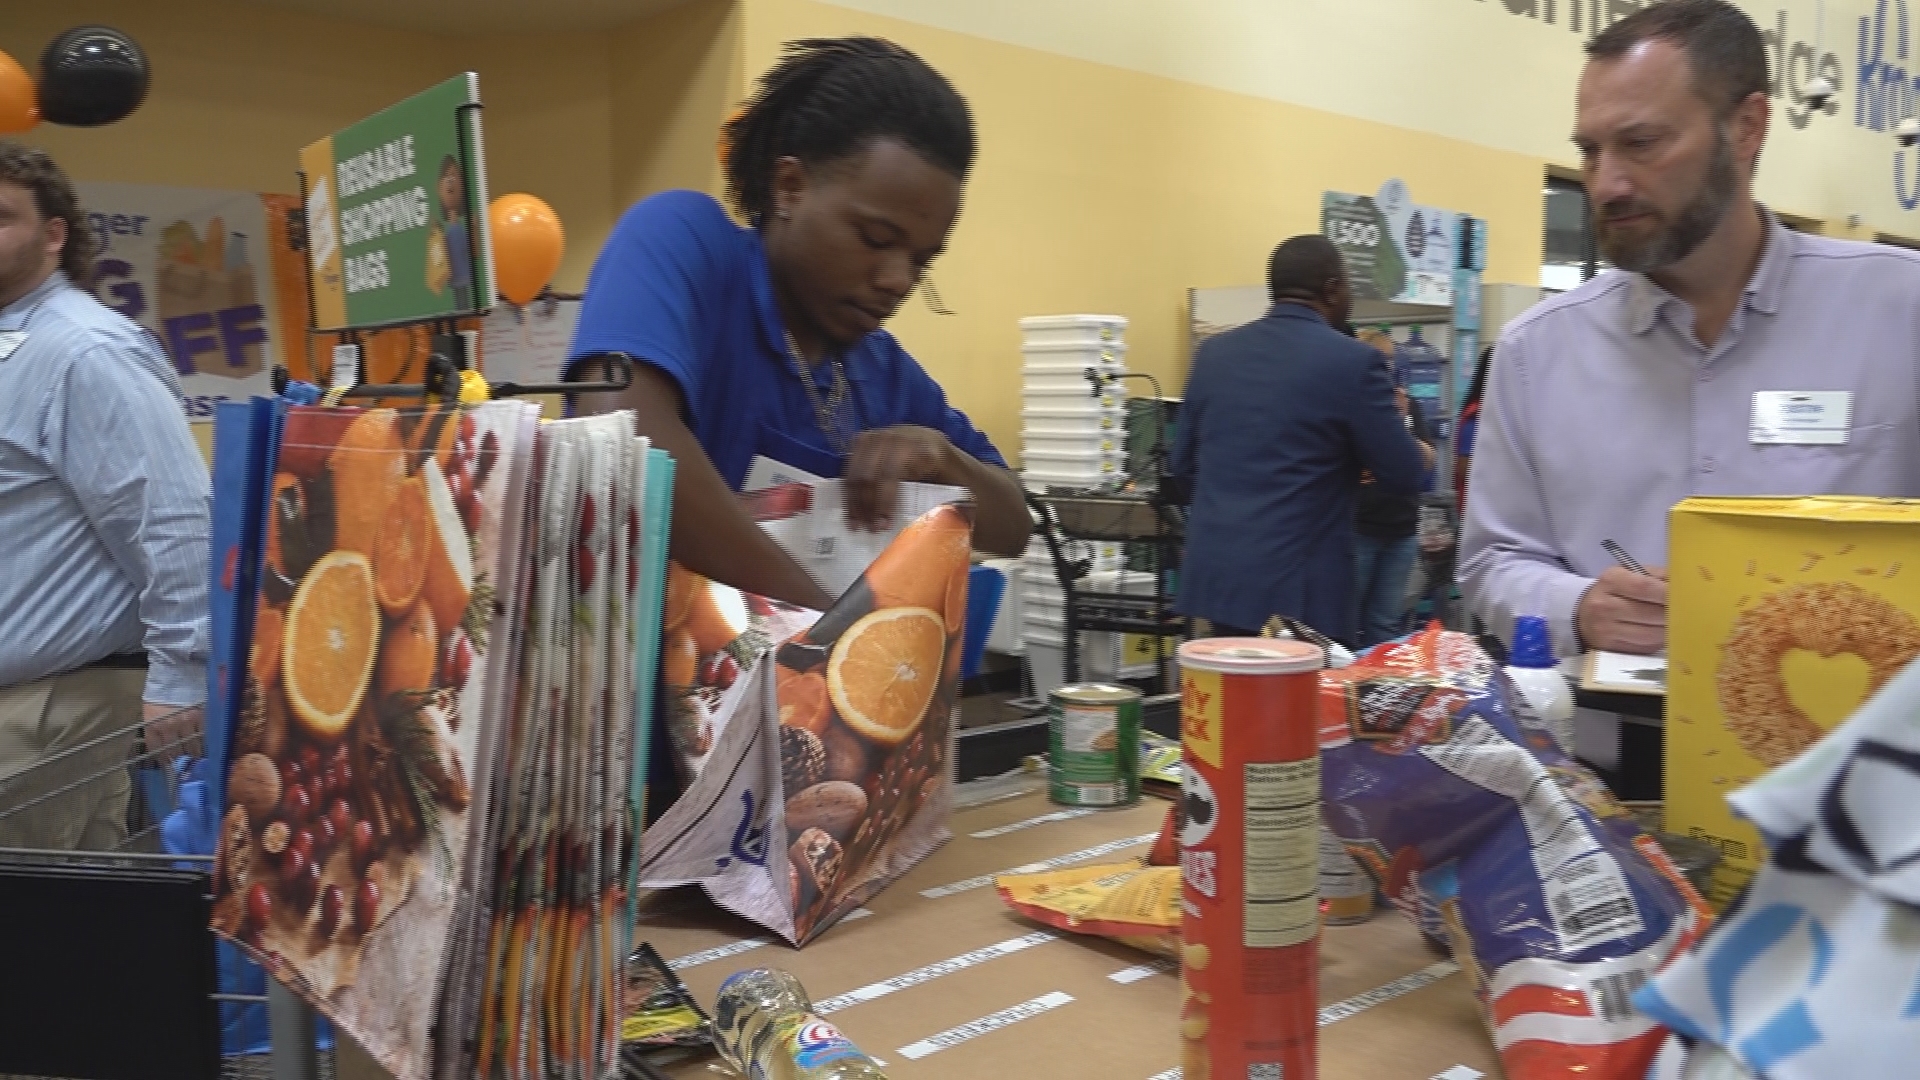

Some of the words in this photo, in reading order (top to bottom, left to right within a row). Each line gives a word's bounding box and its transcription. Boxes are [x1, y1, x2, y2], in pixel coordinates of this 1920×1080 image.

[1764, 10, 1843, 131] dge
[336, 135, 417, 198] REUSABLE
[88, 211, 150, 254] ger
[339, 185, 429, 247] SHOPPING
[95, 258, 148, 317] G
[343, 249, 390, 294] BAGS
[159, 303, 269, 378] FF
[1361, 683, 1412, 724] BORDE
[1245, 765, 1300, 776] Nutrition
[1245, 775, 1285, 785] Datos
[927, 1002, 1049, 1048] CRACKERS
